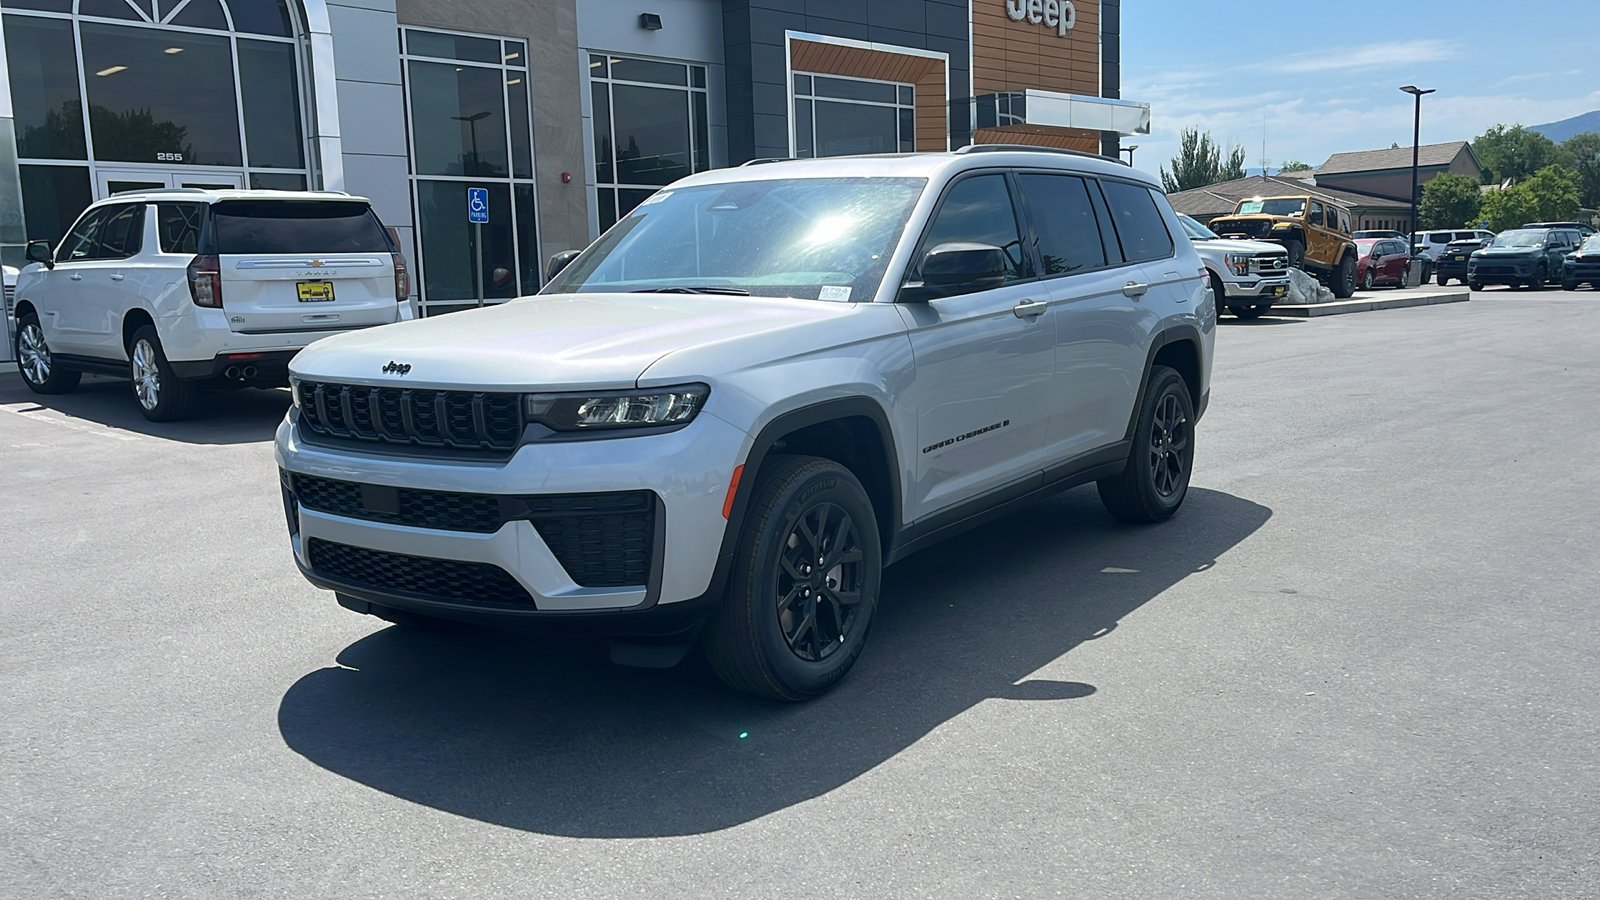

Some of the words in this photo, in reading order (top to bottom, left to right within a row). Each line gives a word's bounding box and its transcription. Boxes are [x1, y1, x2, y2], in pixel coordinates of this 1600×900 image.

[1006, 0, 1076, 37] Jeep
[157, 152, 183, 161] 255
[470, 211, 487, 219] PARKING
[382, 360, 412, 377] Jeep
[922, 437, 955, 454] GRAND
[955, 421, 1003, 442] CHEROKEE
